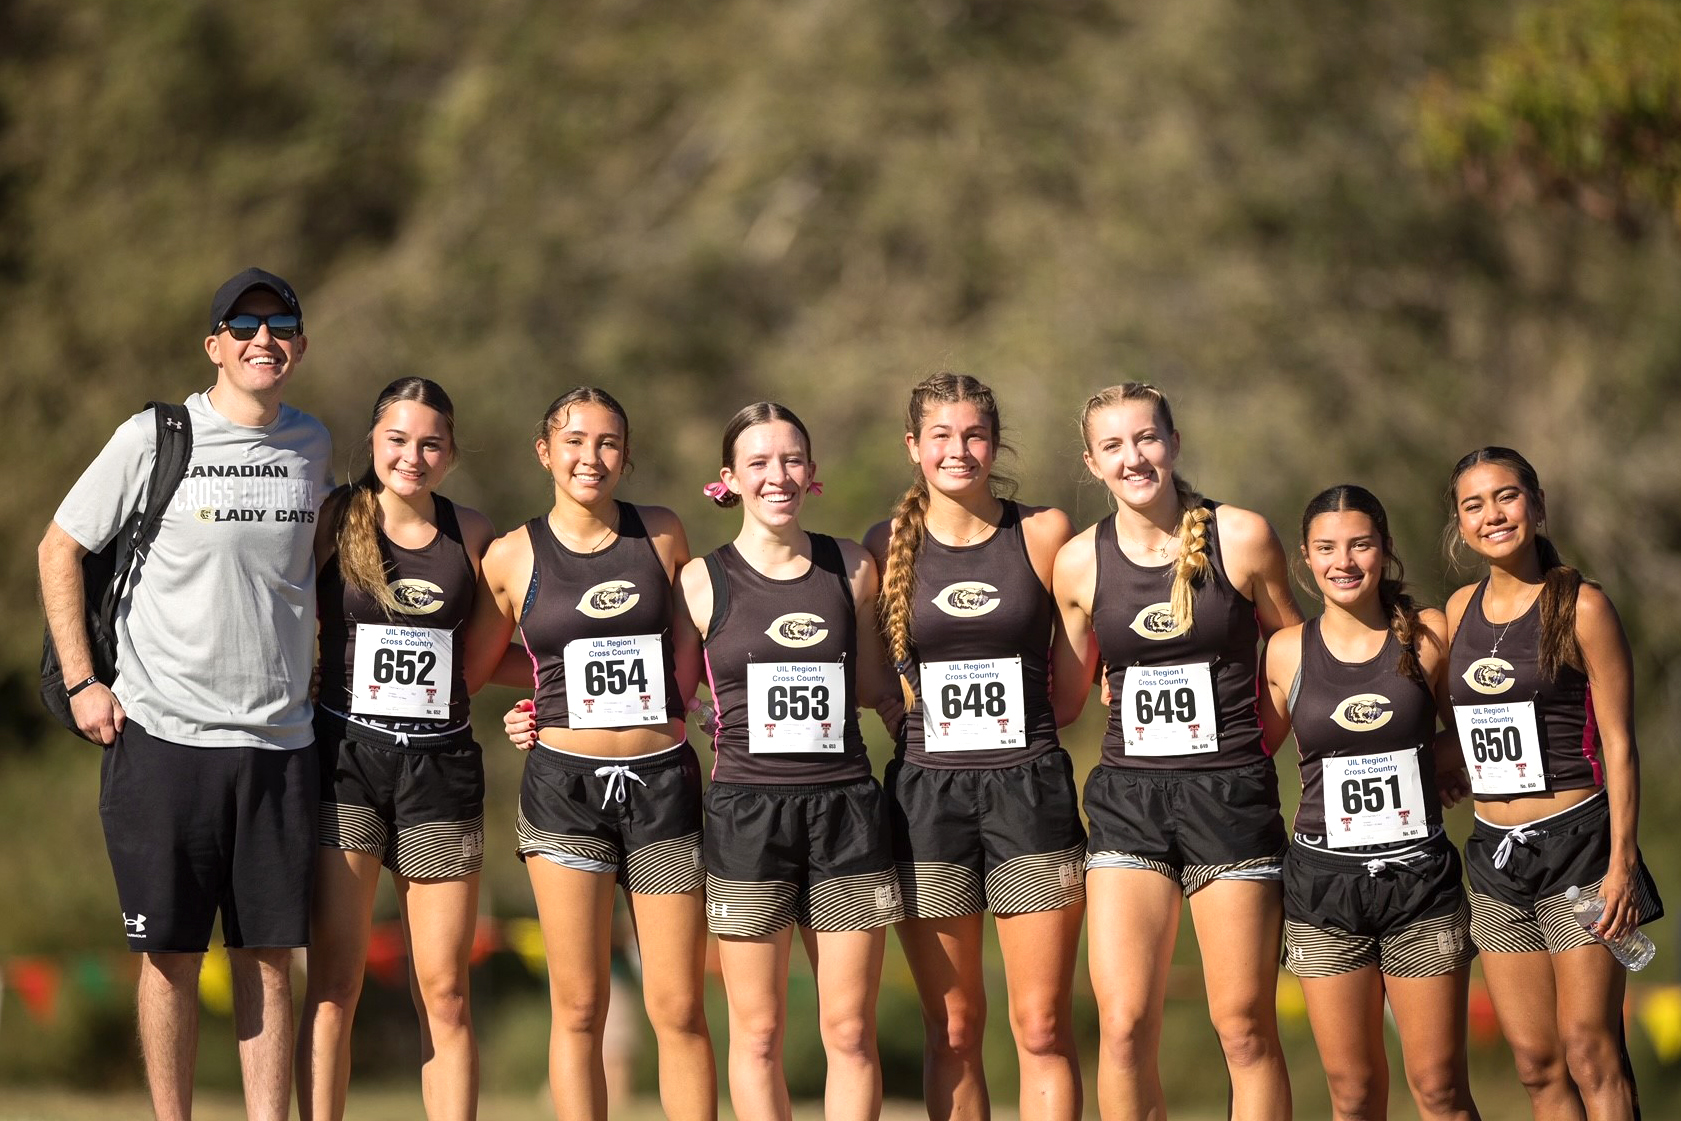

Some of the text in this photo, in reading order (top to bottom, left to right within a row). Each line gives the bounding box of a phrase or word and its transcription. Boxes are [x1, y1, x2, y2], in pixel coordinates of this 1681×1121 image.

[242, 479, 313, 509] COUNTRY
[215, 510, 314, 523] LADY CATS
[400, 630, 425, 638] Region
[405, 639, 433, 648] Country
[607, 639, 631, 647] Region
[374, 648, 436, 686] 652
[585, 658, 648, 696] 654
[964, 663, 990, 671] Region
[768, 685, 829, 721] 653
[941, 682, 1006, 719] 648
[1136, 688, 1196, 724] 649
[1471, 726, 1522, 763] 650
[1362, 757, 1388, 765] Region
[1368, 765, 1398, 774] Country
[1341, 775, 1402, 814] 651
